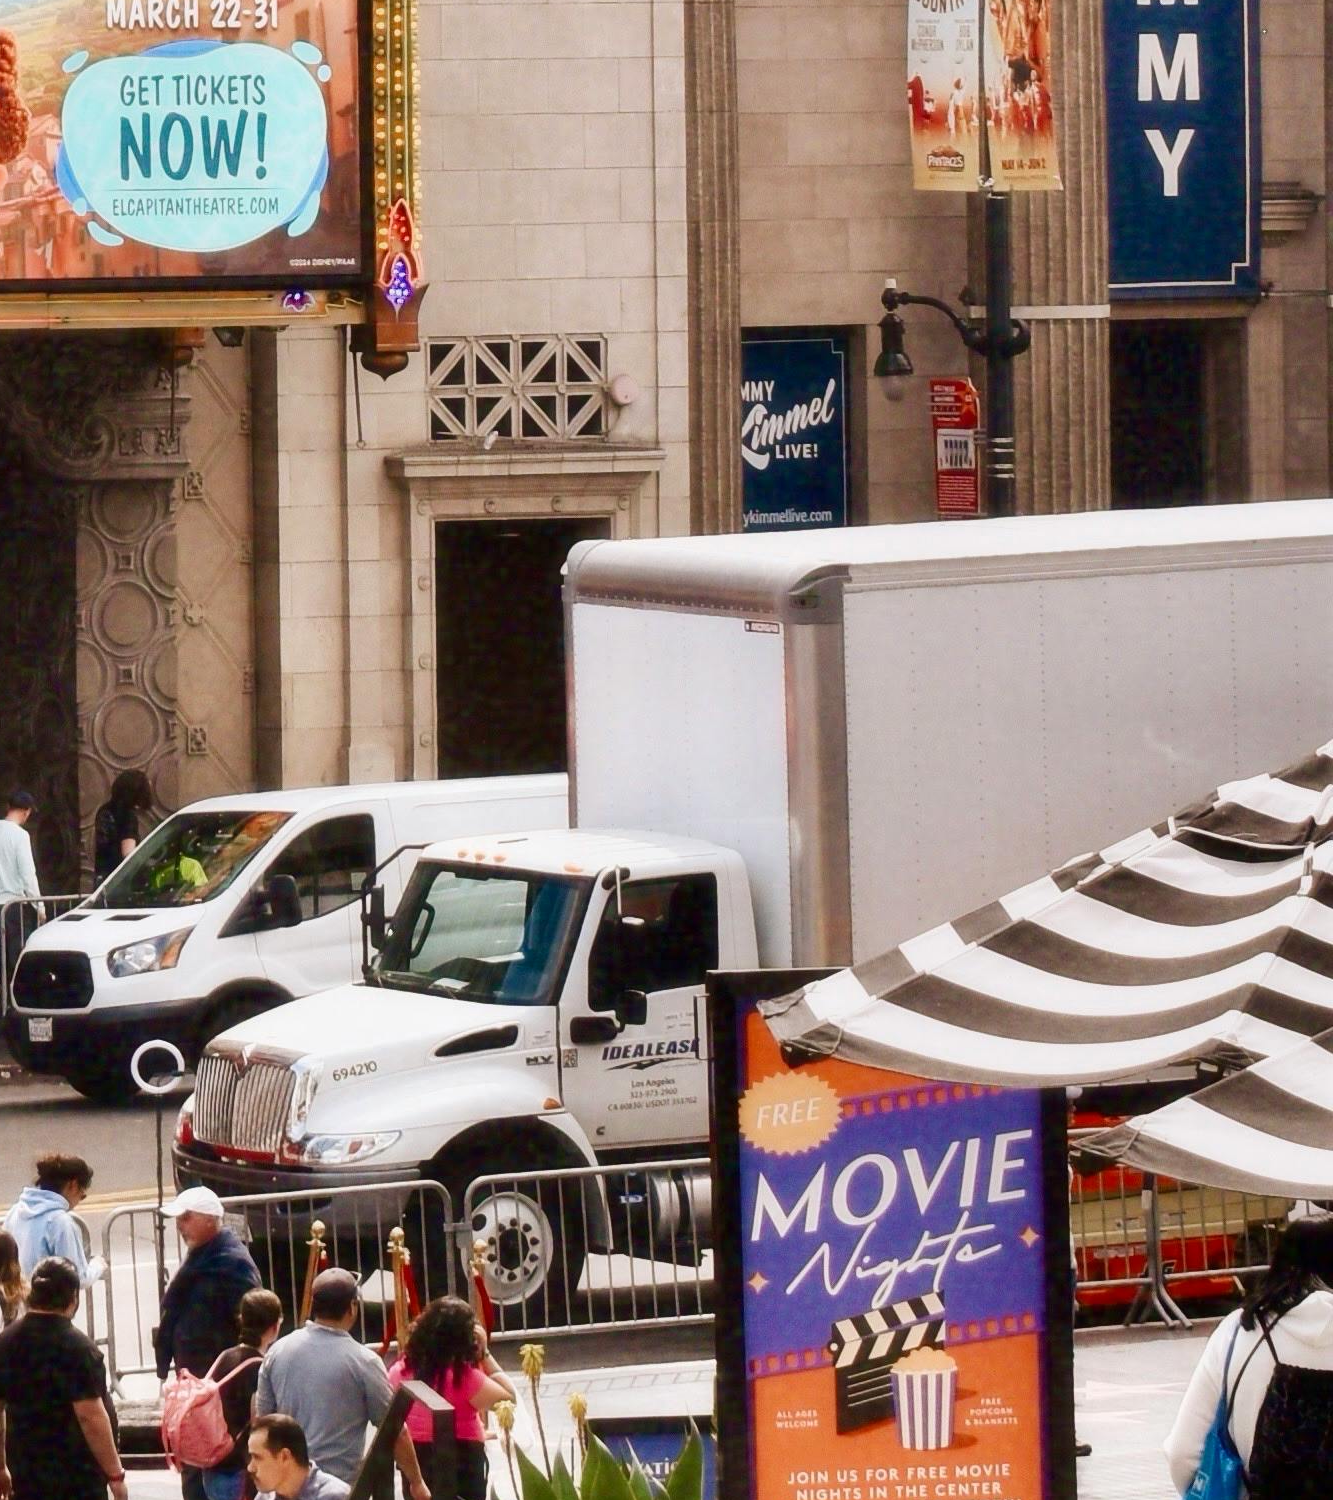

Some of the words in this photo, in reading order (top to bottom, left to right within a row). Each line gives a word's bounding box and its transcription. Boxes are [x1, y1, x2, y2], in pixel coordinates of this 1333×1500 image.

[120, 75, 164, 106] GET
[171, 74, 267, 106] TICKETS
[120, 109, 267, 182] NOW!
[112, 197, 279, 217] ELCAPITANTHEATRE.COM
[741, 380, 775, 402] MMY
[741, 378, 836, 471] Kimmel
[775, 443, 819, 459] LIVE!
[743, 508, 832, 528] ykimmellive.com
[332, 1060, 378, 1082] 694210
[631, 1080, 644, 1088] Los
[646, 1078, 675, 1088] Angeles
[757, 1097, 822, 1129] FREE
[751, 1129, 1033, 1241] MOVIE
[785, 1210, 1003, 1310] Nights
[969, 1407, 1013, 1415] POPCORN
[973, 1416, 1018, 1425] BLANKETS
[776, 1419, 819, 1428] WELCOME
[788, 1471, 829, 1485] JOIN
[836, 1470, 858, 1482] US
[865, 1468, 899, 1482] FOR
[907, 1466, 948, 1479] FREE
[955, 1463, 1011, 1478] MOVIE
[868, 1486, 888, 1499] IN
[894, 1485, 928, 1498] THE
[934, 1481, 1003, 1496] CENTER
